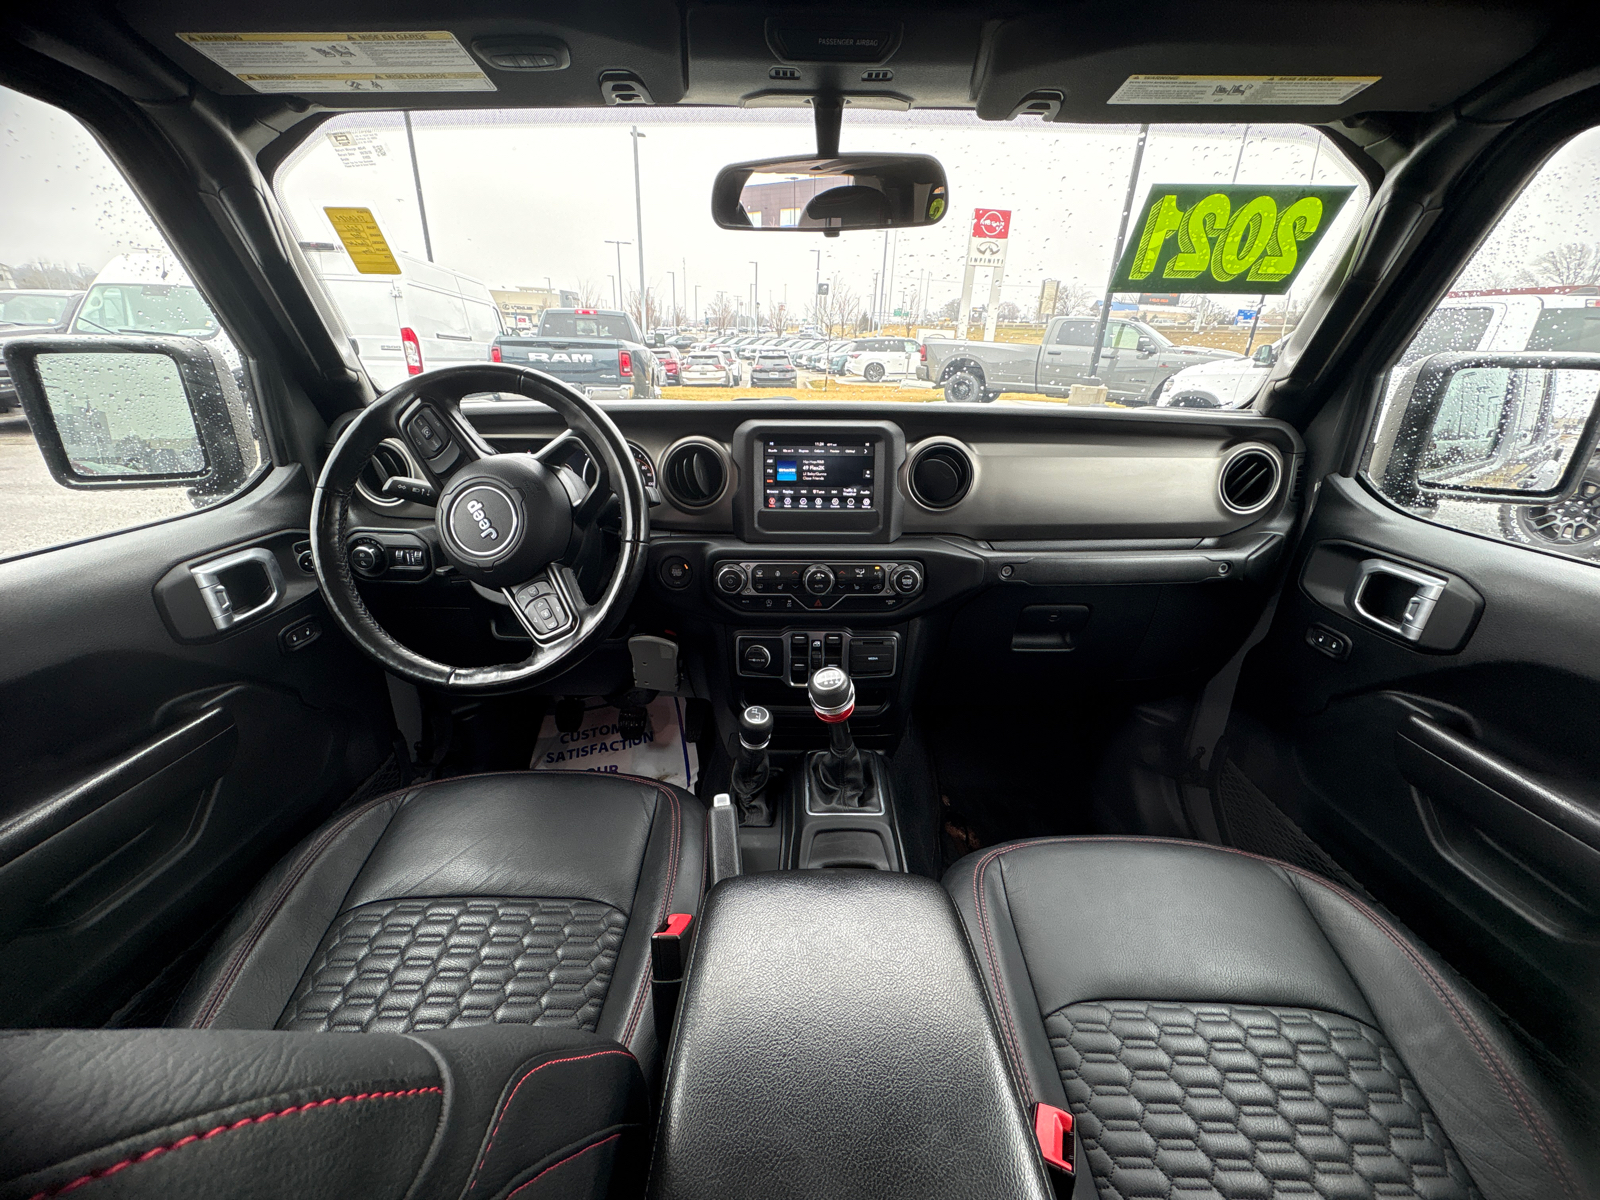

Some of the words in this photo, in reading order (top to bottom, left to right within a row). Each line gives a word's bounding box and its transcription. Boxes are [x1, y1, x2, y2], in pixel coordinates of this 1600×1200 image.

[358, 33, 377, 41] MISE
[395, 33, 428, 41] GARDE
[818, 37, 854, 46] PASSENGER
[856, 38, 878, 47] AIRBAG
[970, 257, 1004, 265] INFINITI
[528, 352, 594, 363] RAM
[467, 500, 498, 540] Jeep
[560, 724, 622, 745] CUSTOM
[546, 731, 654, 764] SATISFACTION
